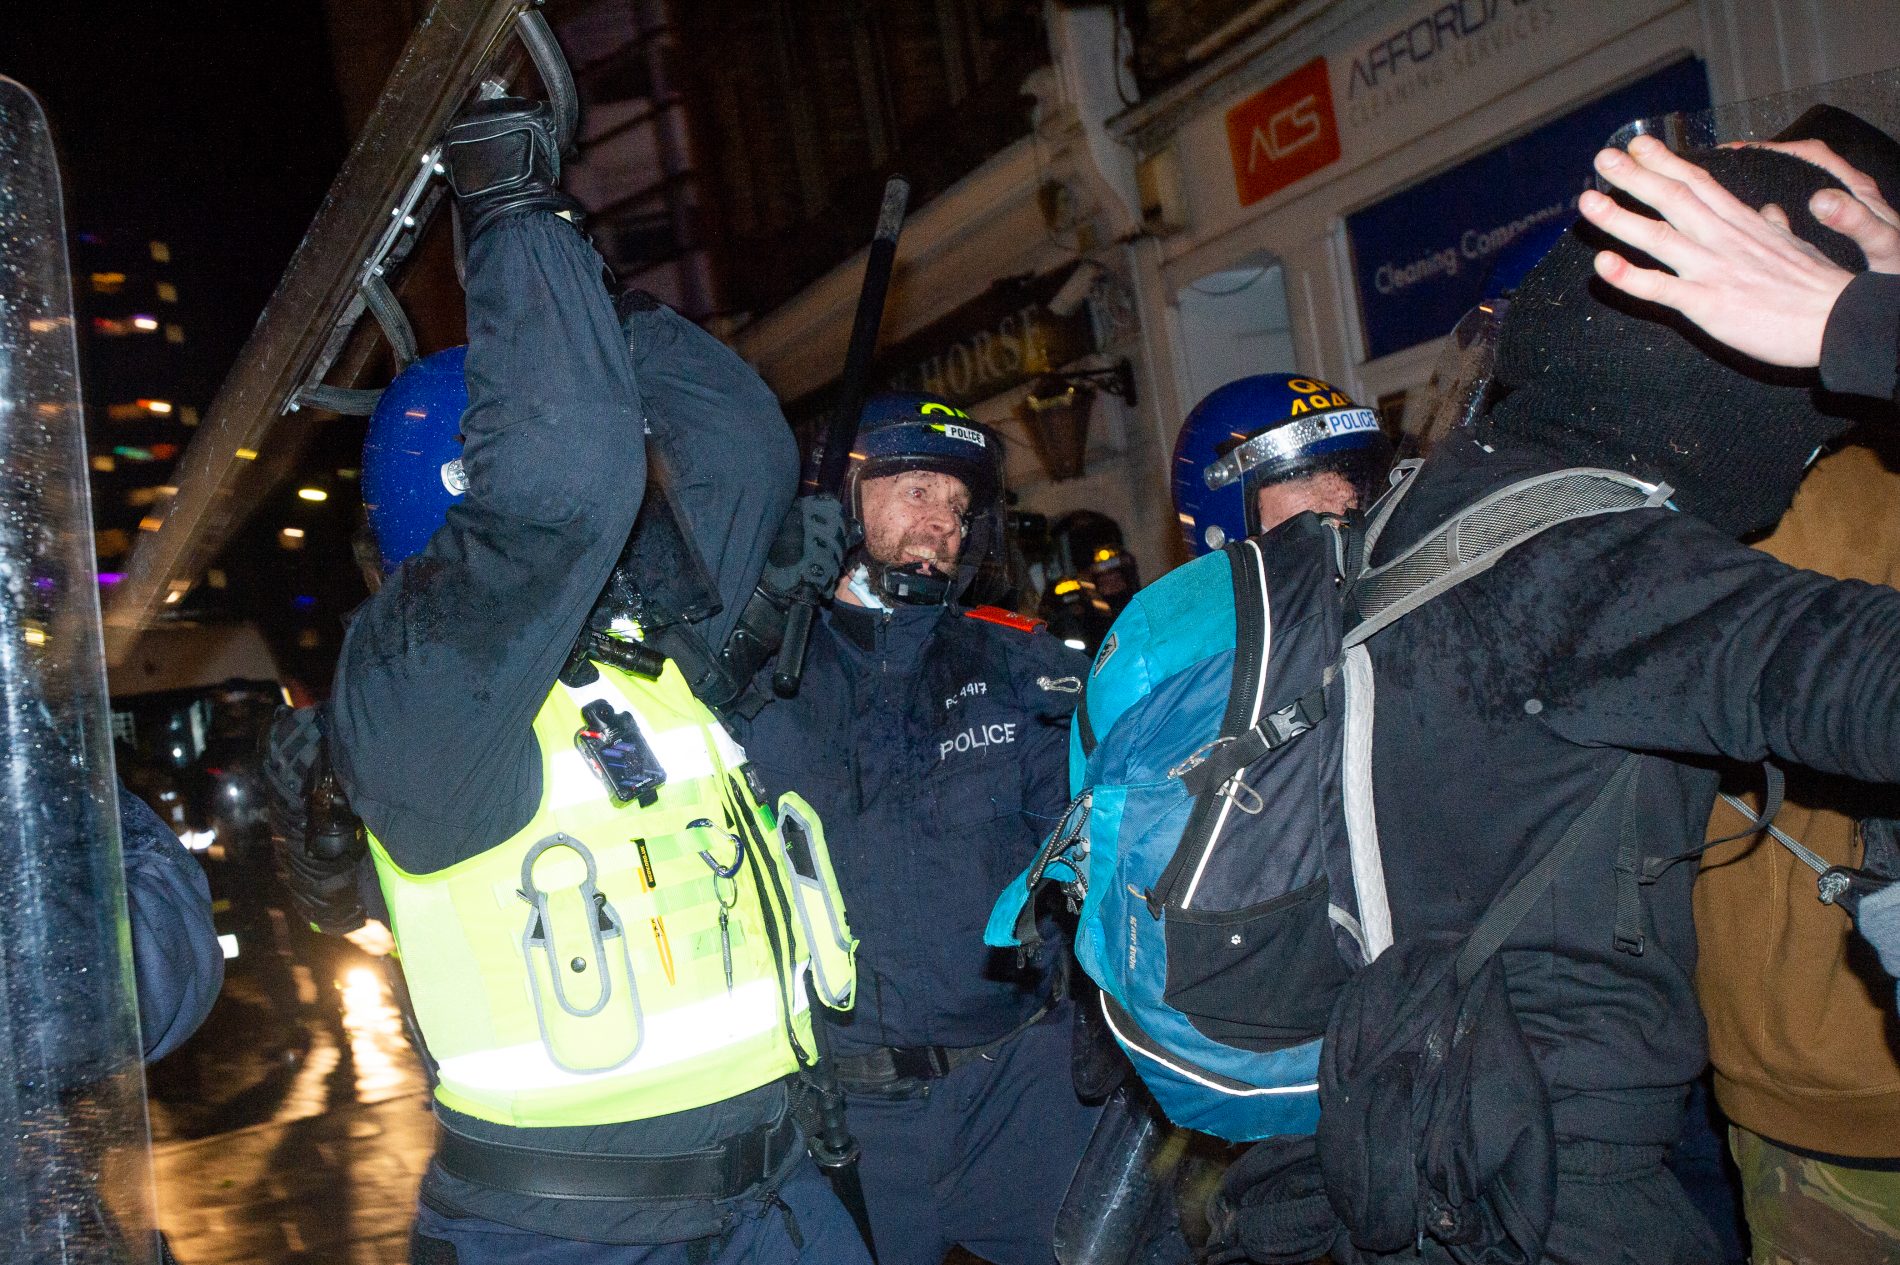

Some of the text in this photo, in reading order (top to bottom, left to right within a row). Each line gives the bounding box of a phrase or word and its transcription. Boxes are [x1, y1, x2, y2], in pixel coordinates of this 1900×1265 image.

[1249, 95, 1321, 172] ACS
[1375, 246, 1457, 295] Cleaning
[951, 427, 981, 443] POLICE
[1329, 411, 1377, 433] POLICE
[940, 723, 1016, 760] POLICE
